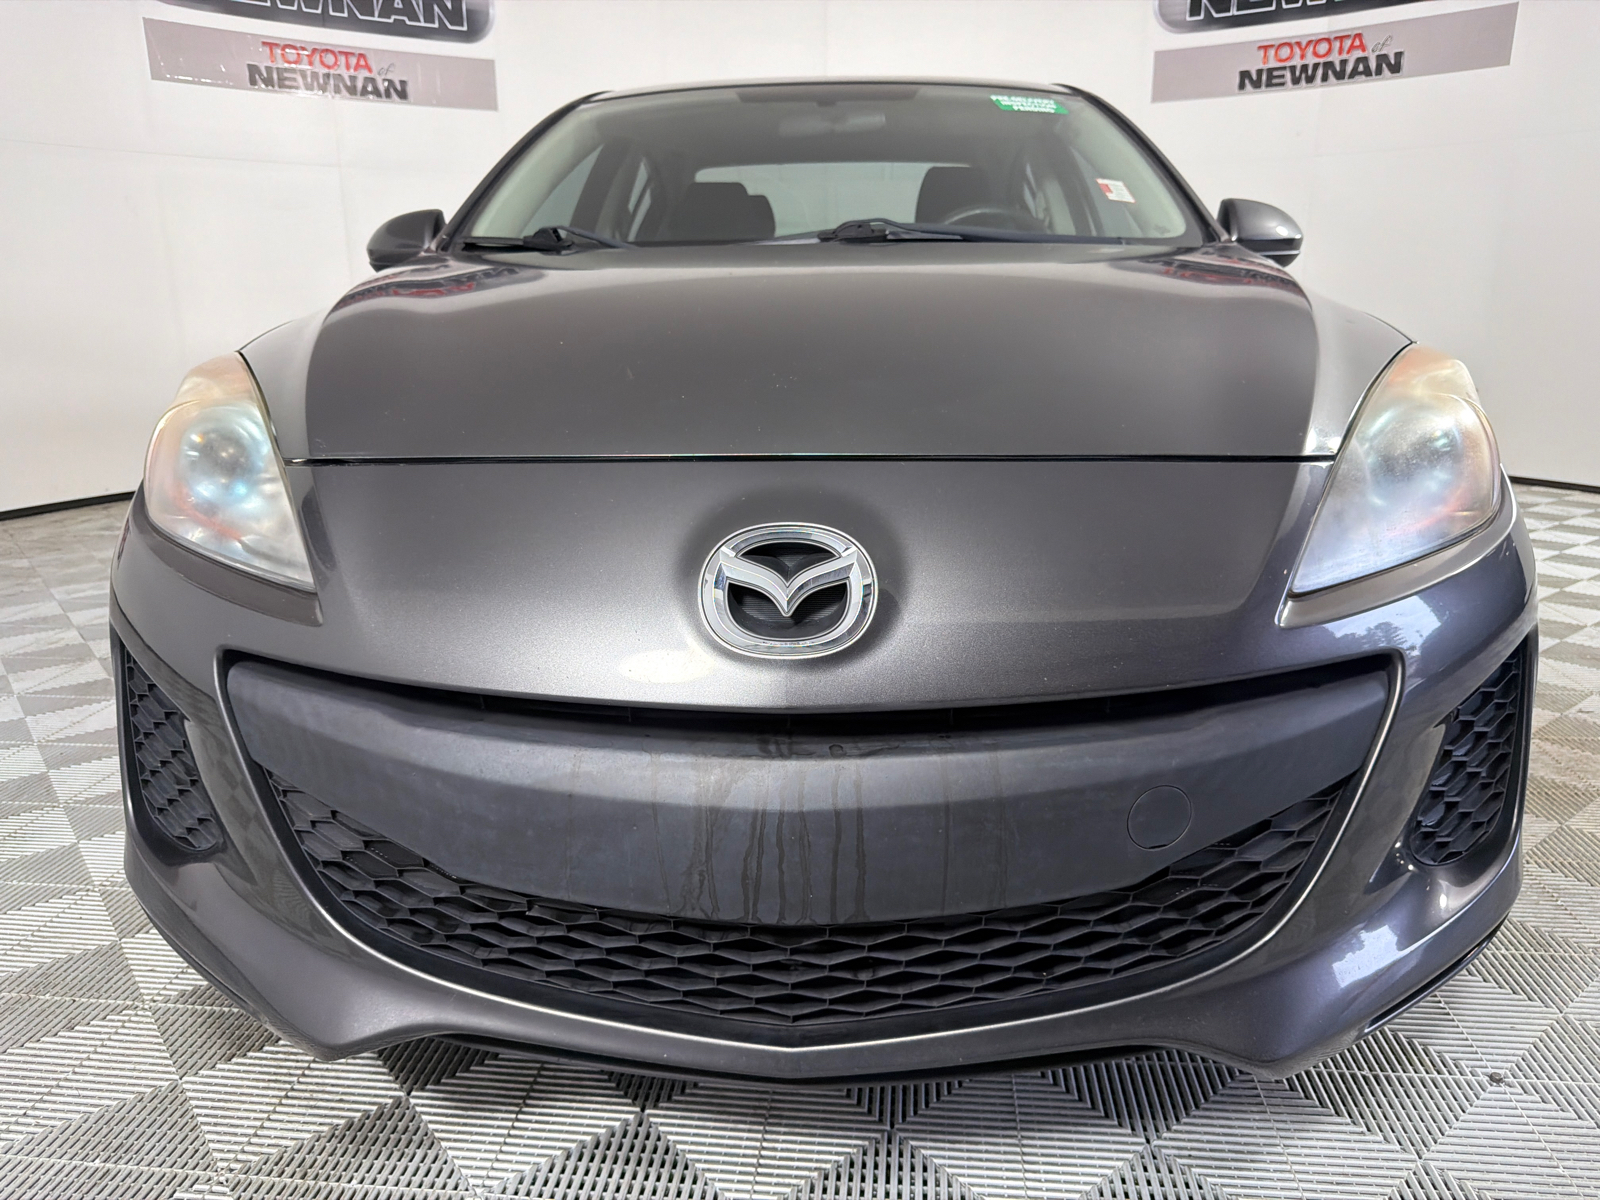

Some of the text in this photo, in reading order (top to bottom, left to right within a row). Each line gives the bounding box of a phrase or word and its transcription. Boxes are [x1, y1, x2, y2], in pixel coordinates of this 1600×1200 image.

[261, 41, 395, 76] TOYOTA of
[1257, 33, 1393, 65] TOYOTA of
[246, 63, 409, 101] NEWNAN
[1238, 51, 1404, 91] NEWNAN
